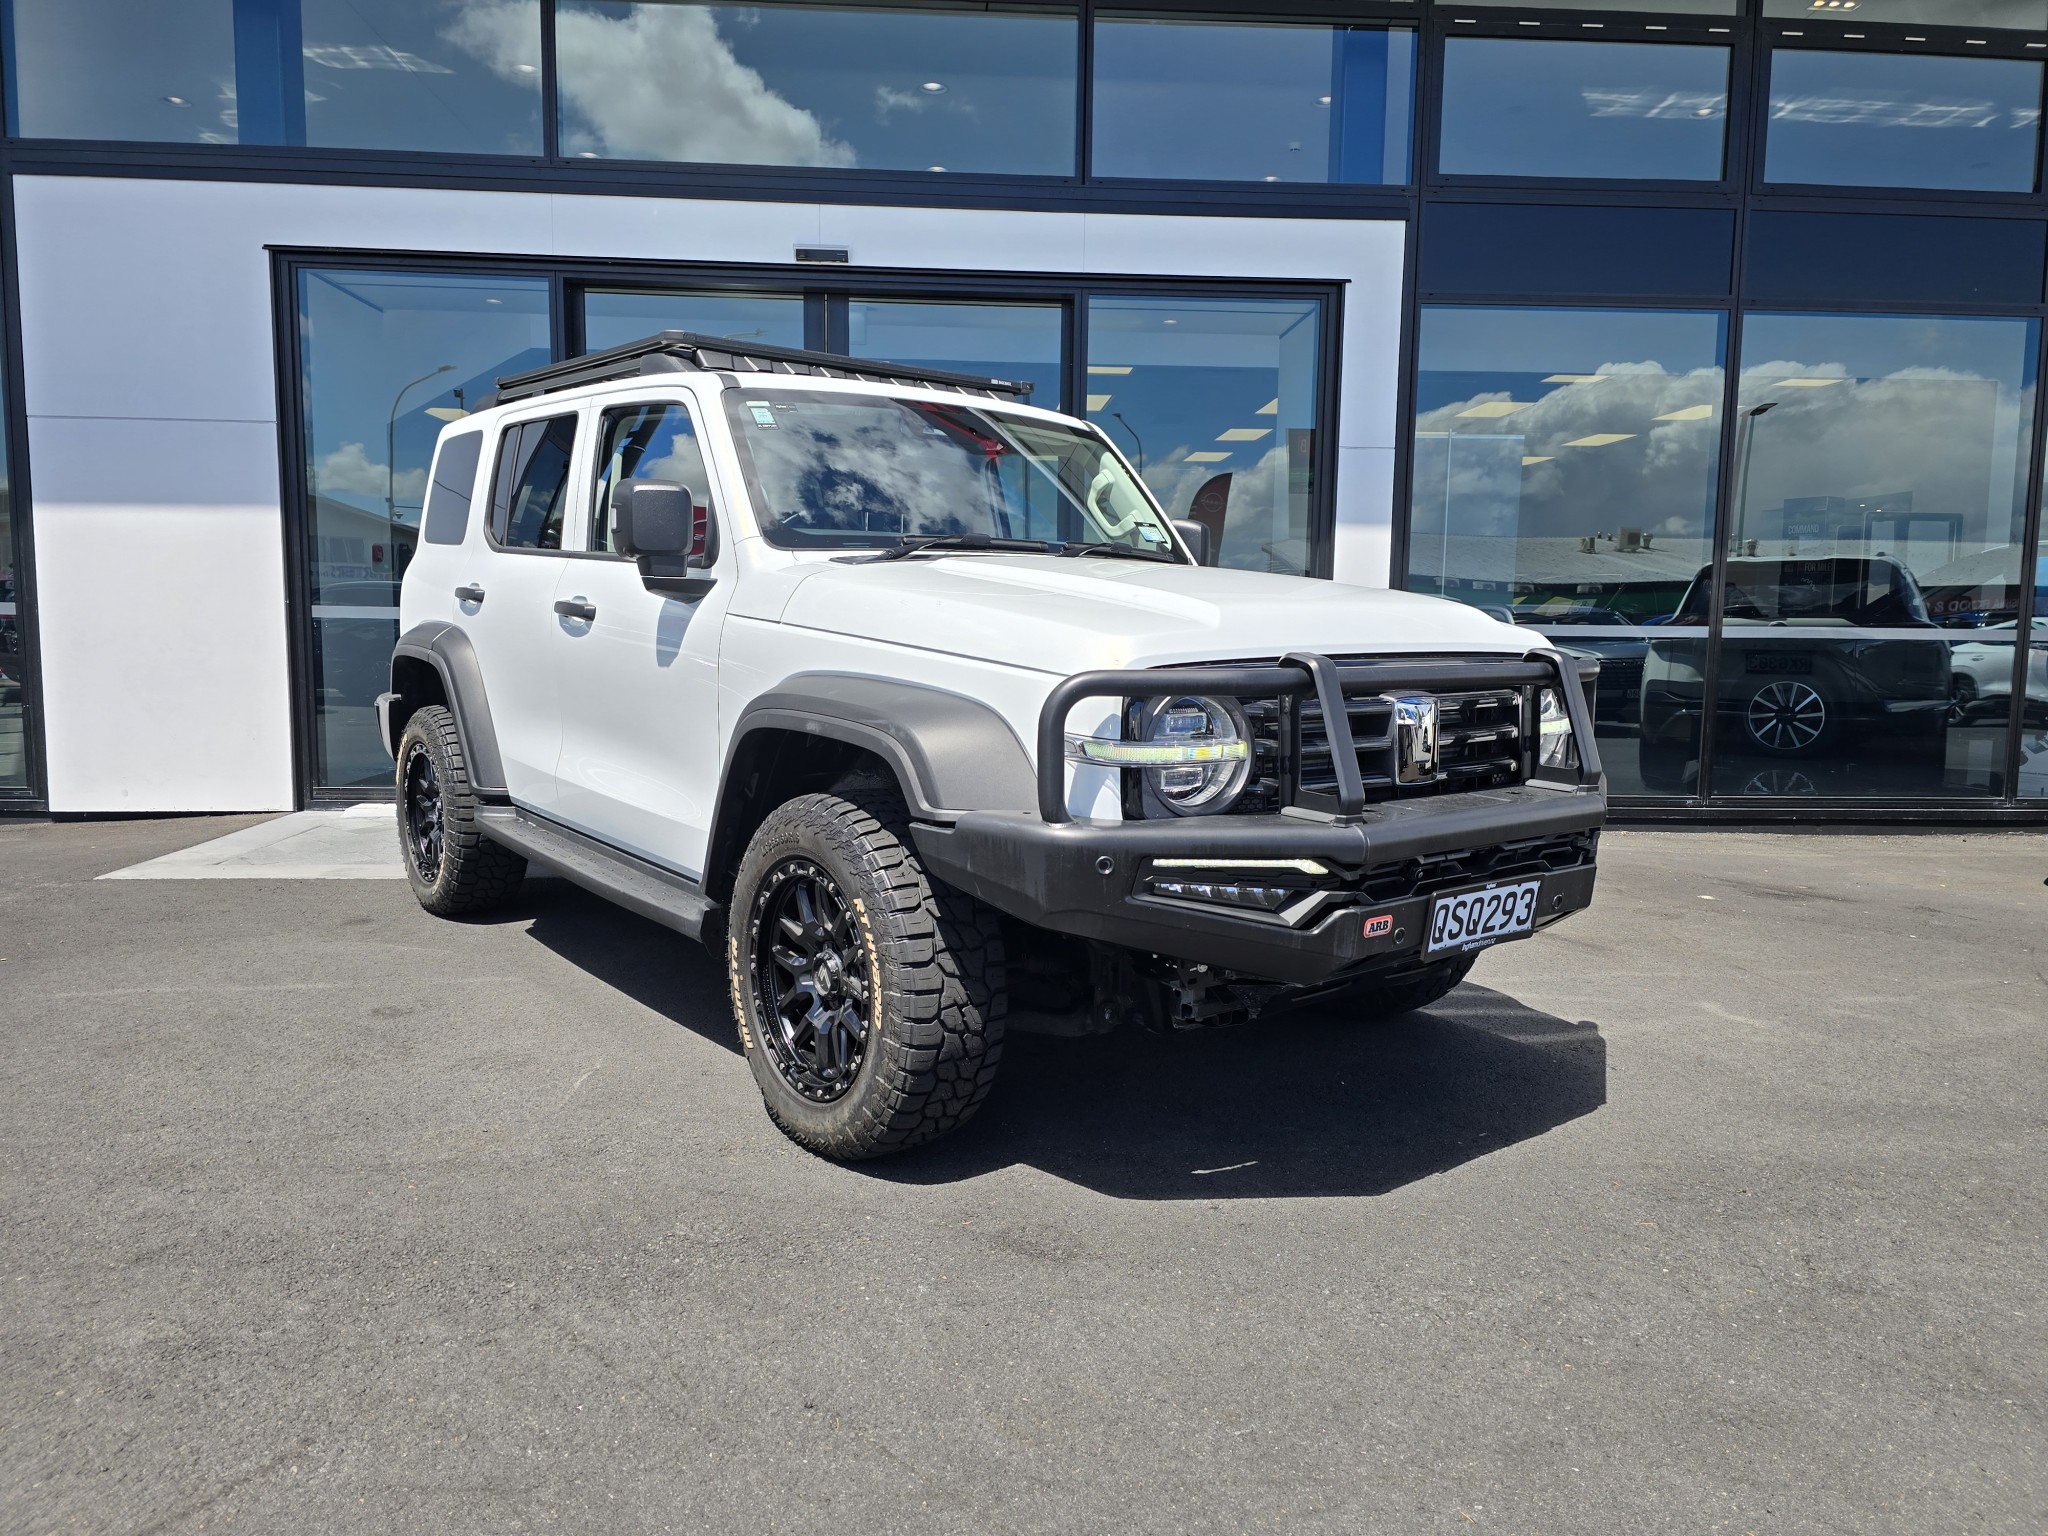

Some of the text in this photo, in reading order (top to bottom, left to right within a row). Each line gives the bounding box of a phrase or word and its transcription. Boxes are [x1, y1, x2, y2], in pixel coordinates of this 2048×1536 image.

[1788, 523, 1820, 535] COMMAND
[1367, 919, 1389, 934] ARB
[1431, 887, 1536, 945] QSQ293
[853, 897, 884, 1032] RT HYBRID
